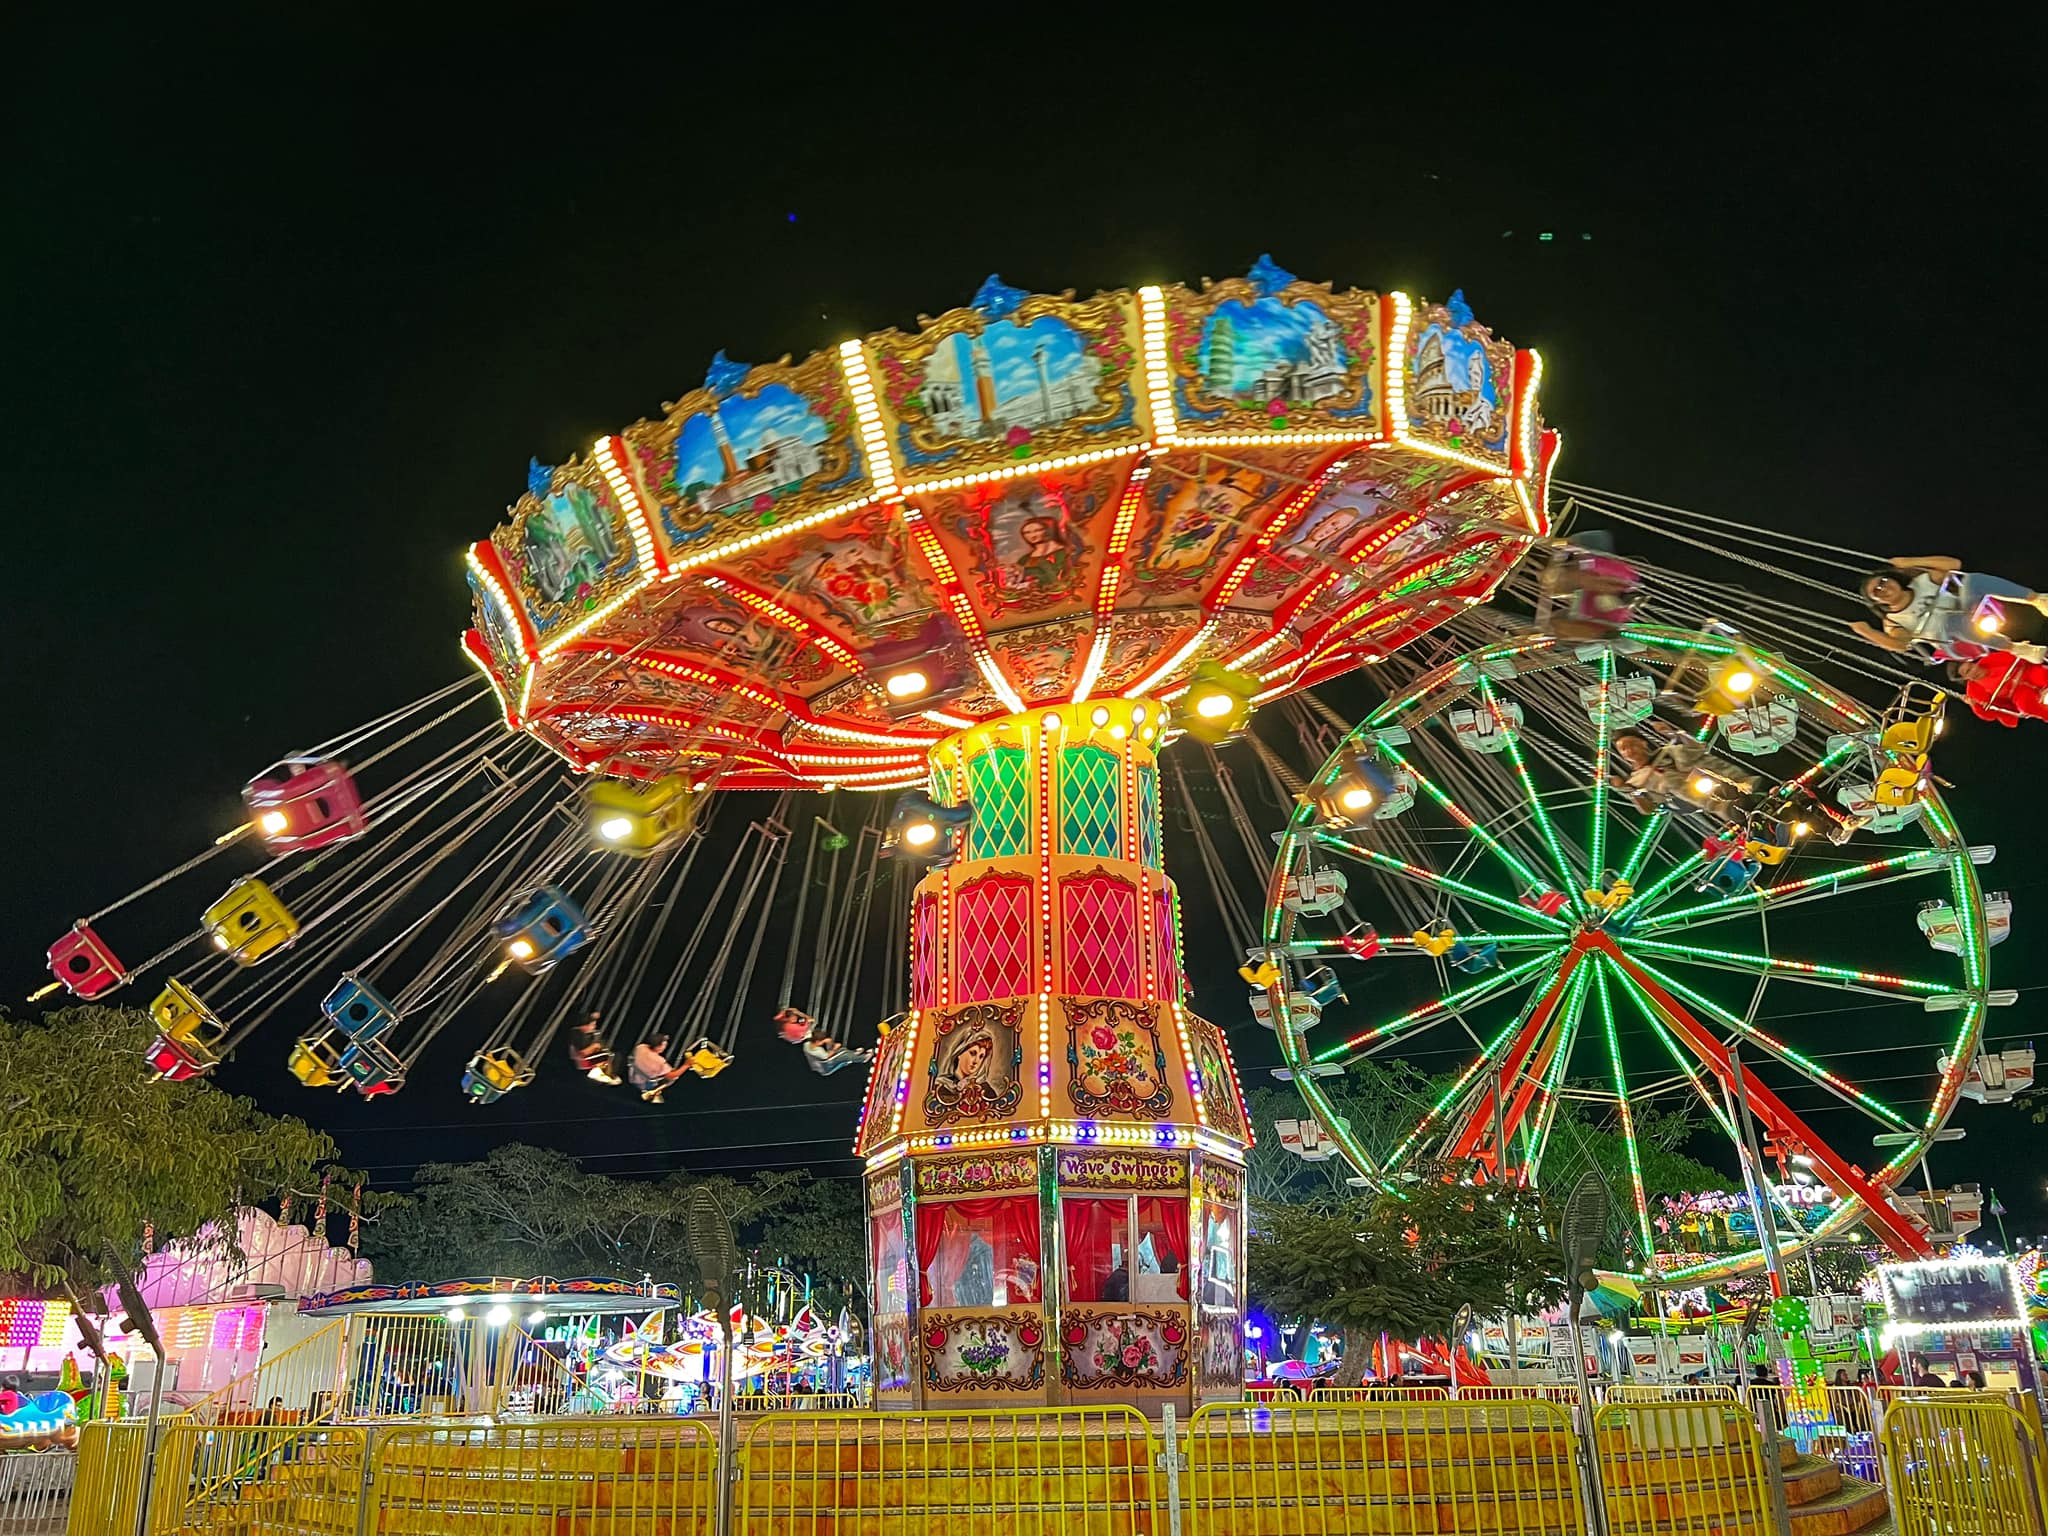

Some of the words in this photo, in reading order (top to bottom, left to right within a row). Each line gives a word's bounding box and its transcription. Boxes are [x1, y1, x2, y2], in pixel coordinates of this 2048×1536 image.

[1629, 671, 1640, 679] 11
[1065, 1160, 1104, 1177] Wave
[1111, 1160, 1178, 1180] Swinger
[1954, 1184, 1963, 1193] 6
[1682, 1327, 1690, 1335] 4
